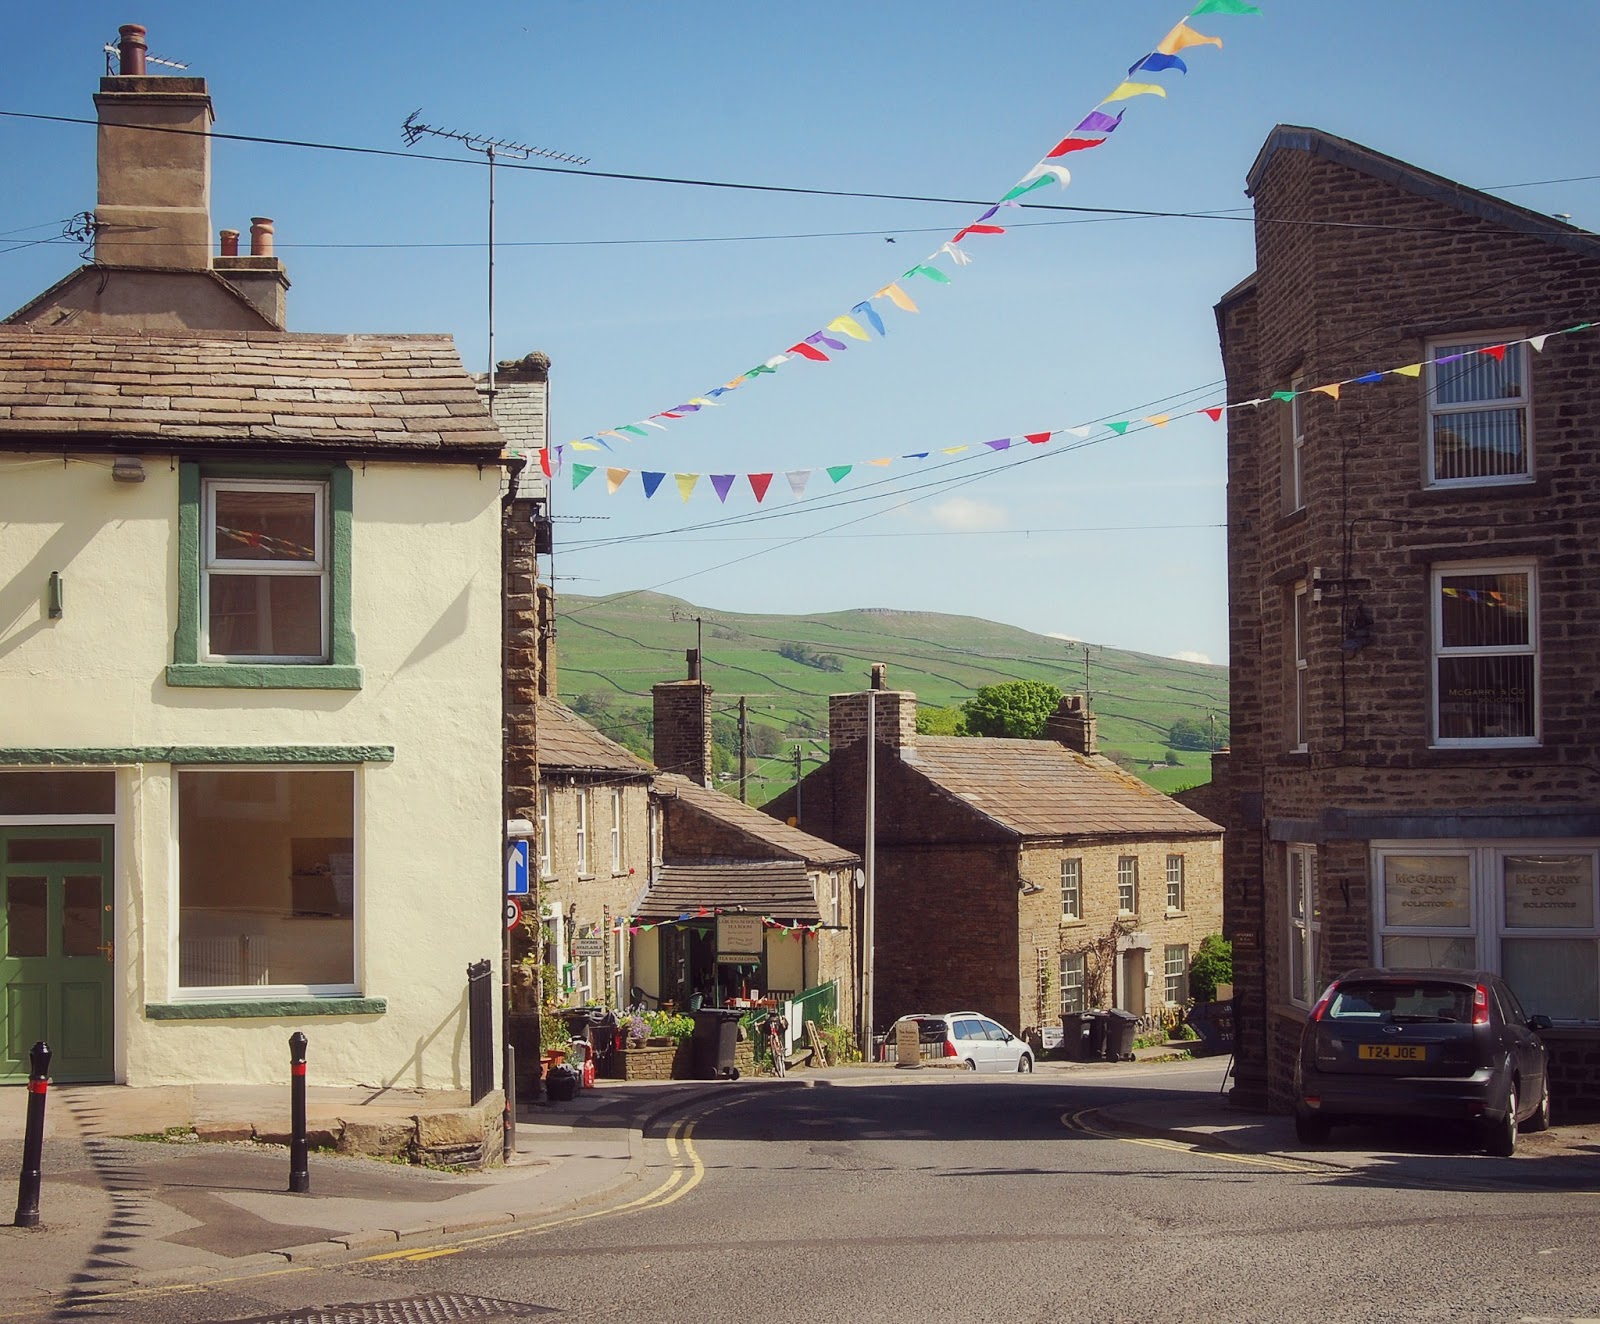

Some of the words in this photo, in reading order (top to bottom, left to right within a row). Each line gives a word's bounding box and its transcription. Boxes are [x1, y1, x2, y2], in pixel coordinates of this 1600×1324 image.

[1401, 900, 1454, 908] SOLICITORS
[1522, 901, 1577, 909] SOLICITORS
[1367, 1046, 1390, 1058] T24
[1394, 1047, 1417, 1059] JOE
